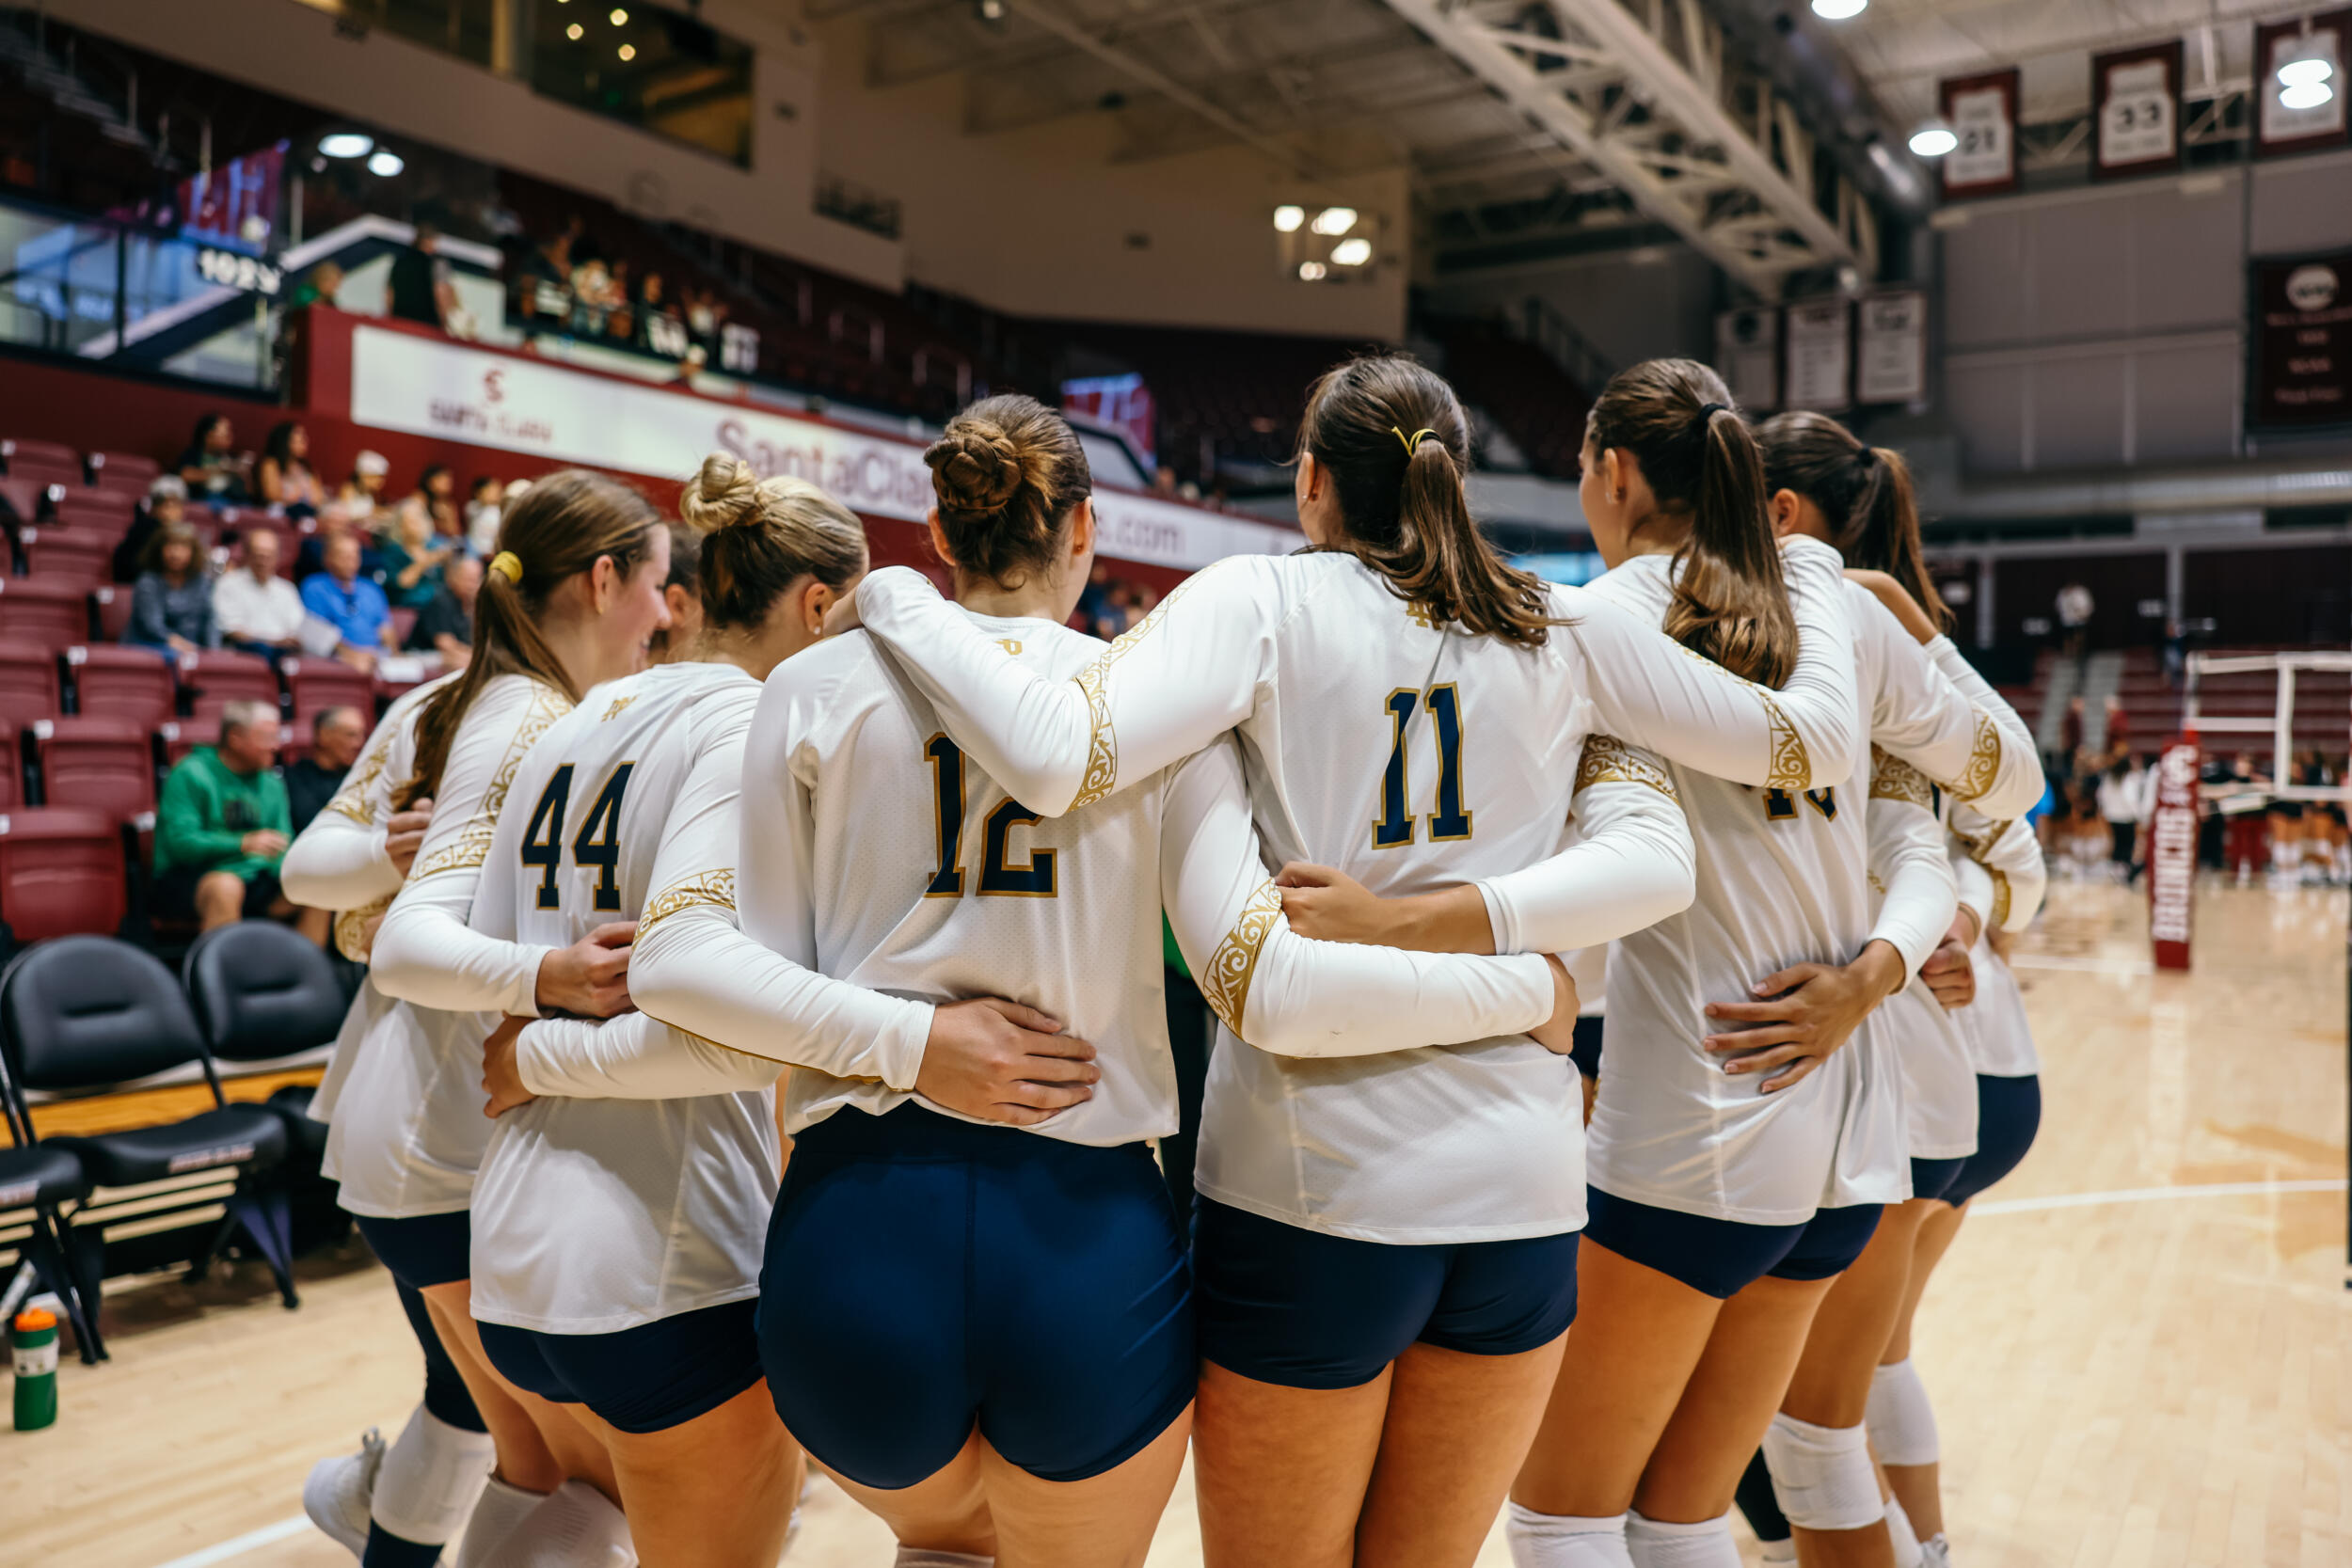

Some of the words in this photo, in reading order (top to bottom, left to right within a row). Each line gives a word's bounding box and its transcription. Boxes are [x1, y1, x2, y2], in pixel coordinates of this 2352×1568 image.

[521, 760, 636, 911] 44
[923, 731, 1058, 898] 12
[1372, 682, 1472, 850] 11
